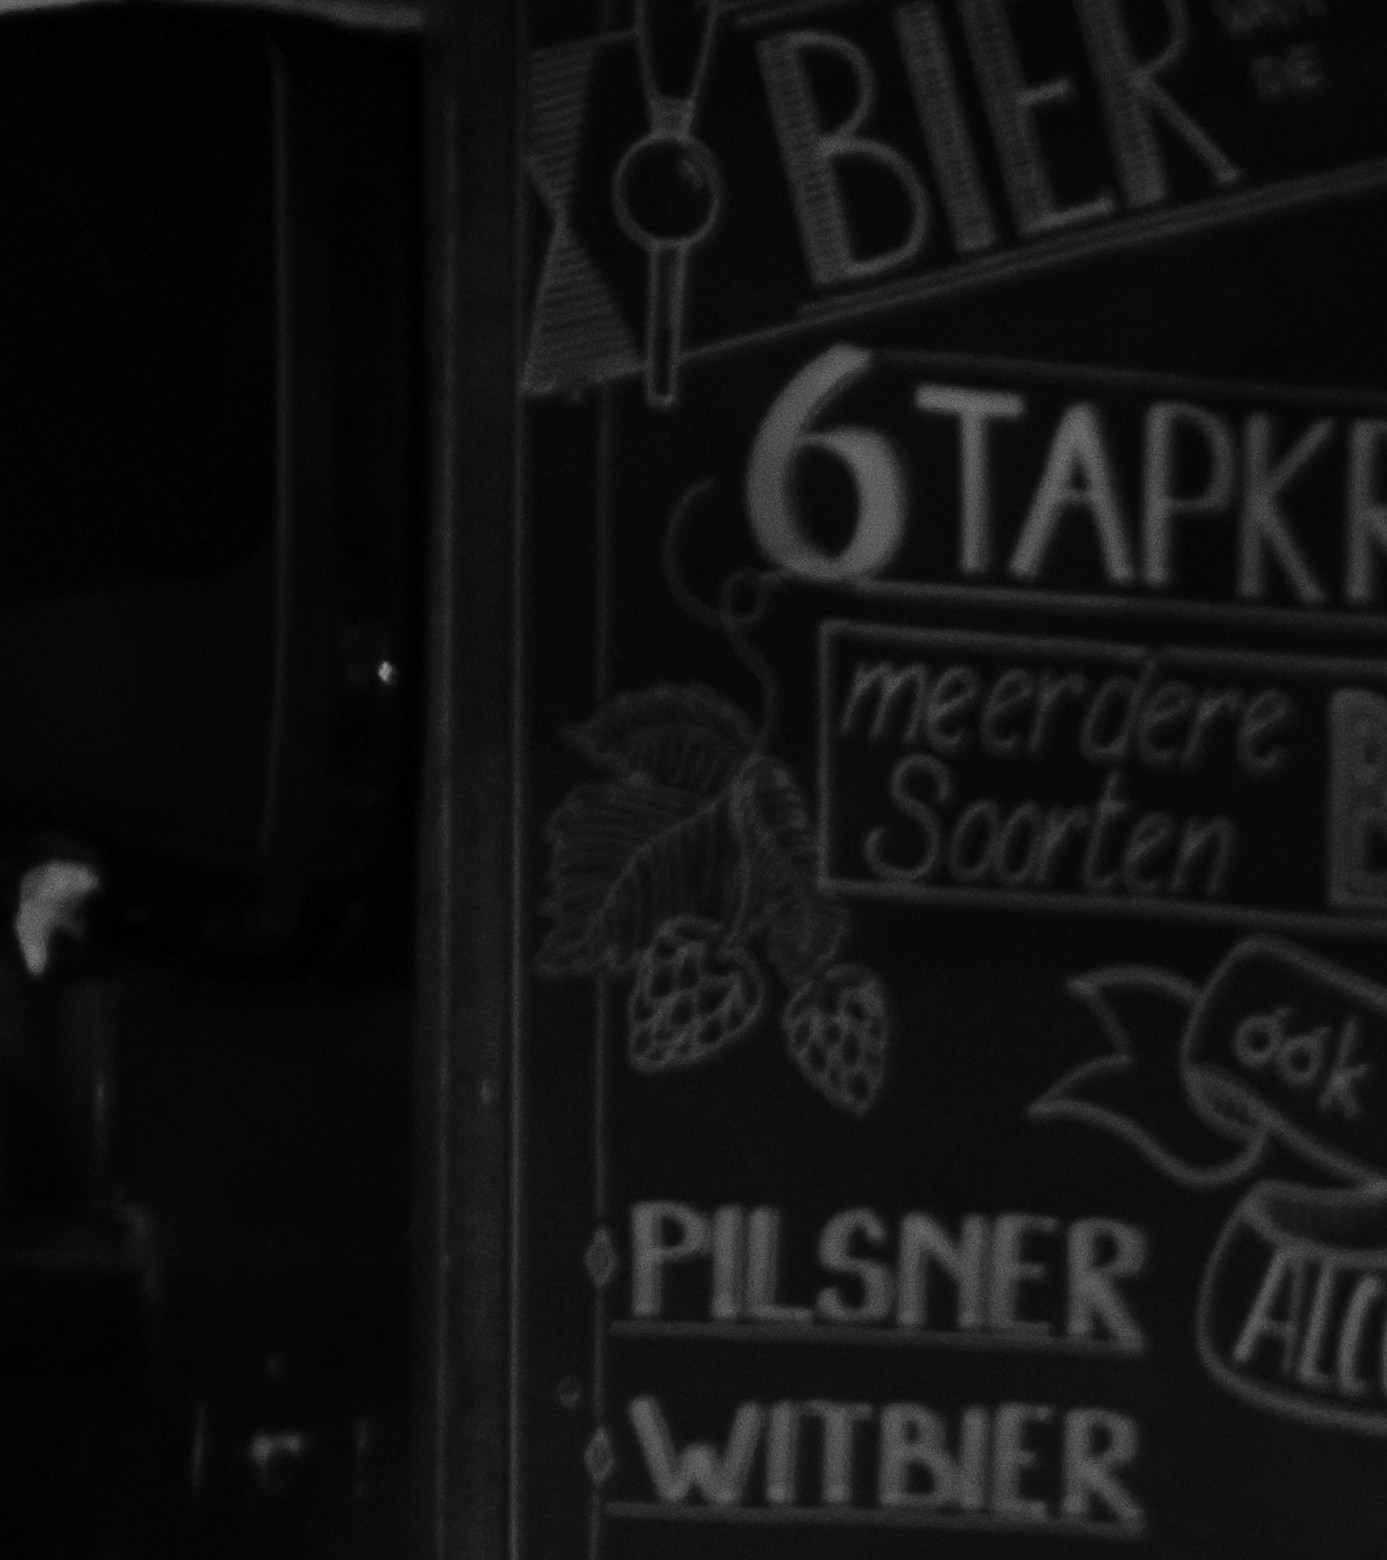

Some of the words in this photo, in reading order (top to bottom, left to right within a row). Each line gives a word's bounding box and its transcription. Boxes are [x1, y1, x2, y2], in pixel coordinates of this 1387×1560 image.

[743, 340, 909, 583] 6
[837, 647, 1296, 777] meerdere
[861, 753, 1240, 898] Soorten
[626, 1200, 1148, 1344] PILSNER
[626, 1394, 1145, 1525] WITBIER
